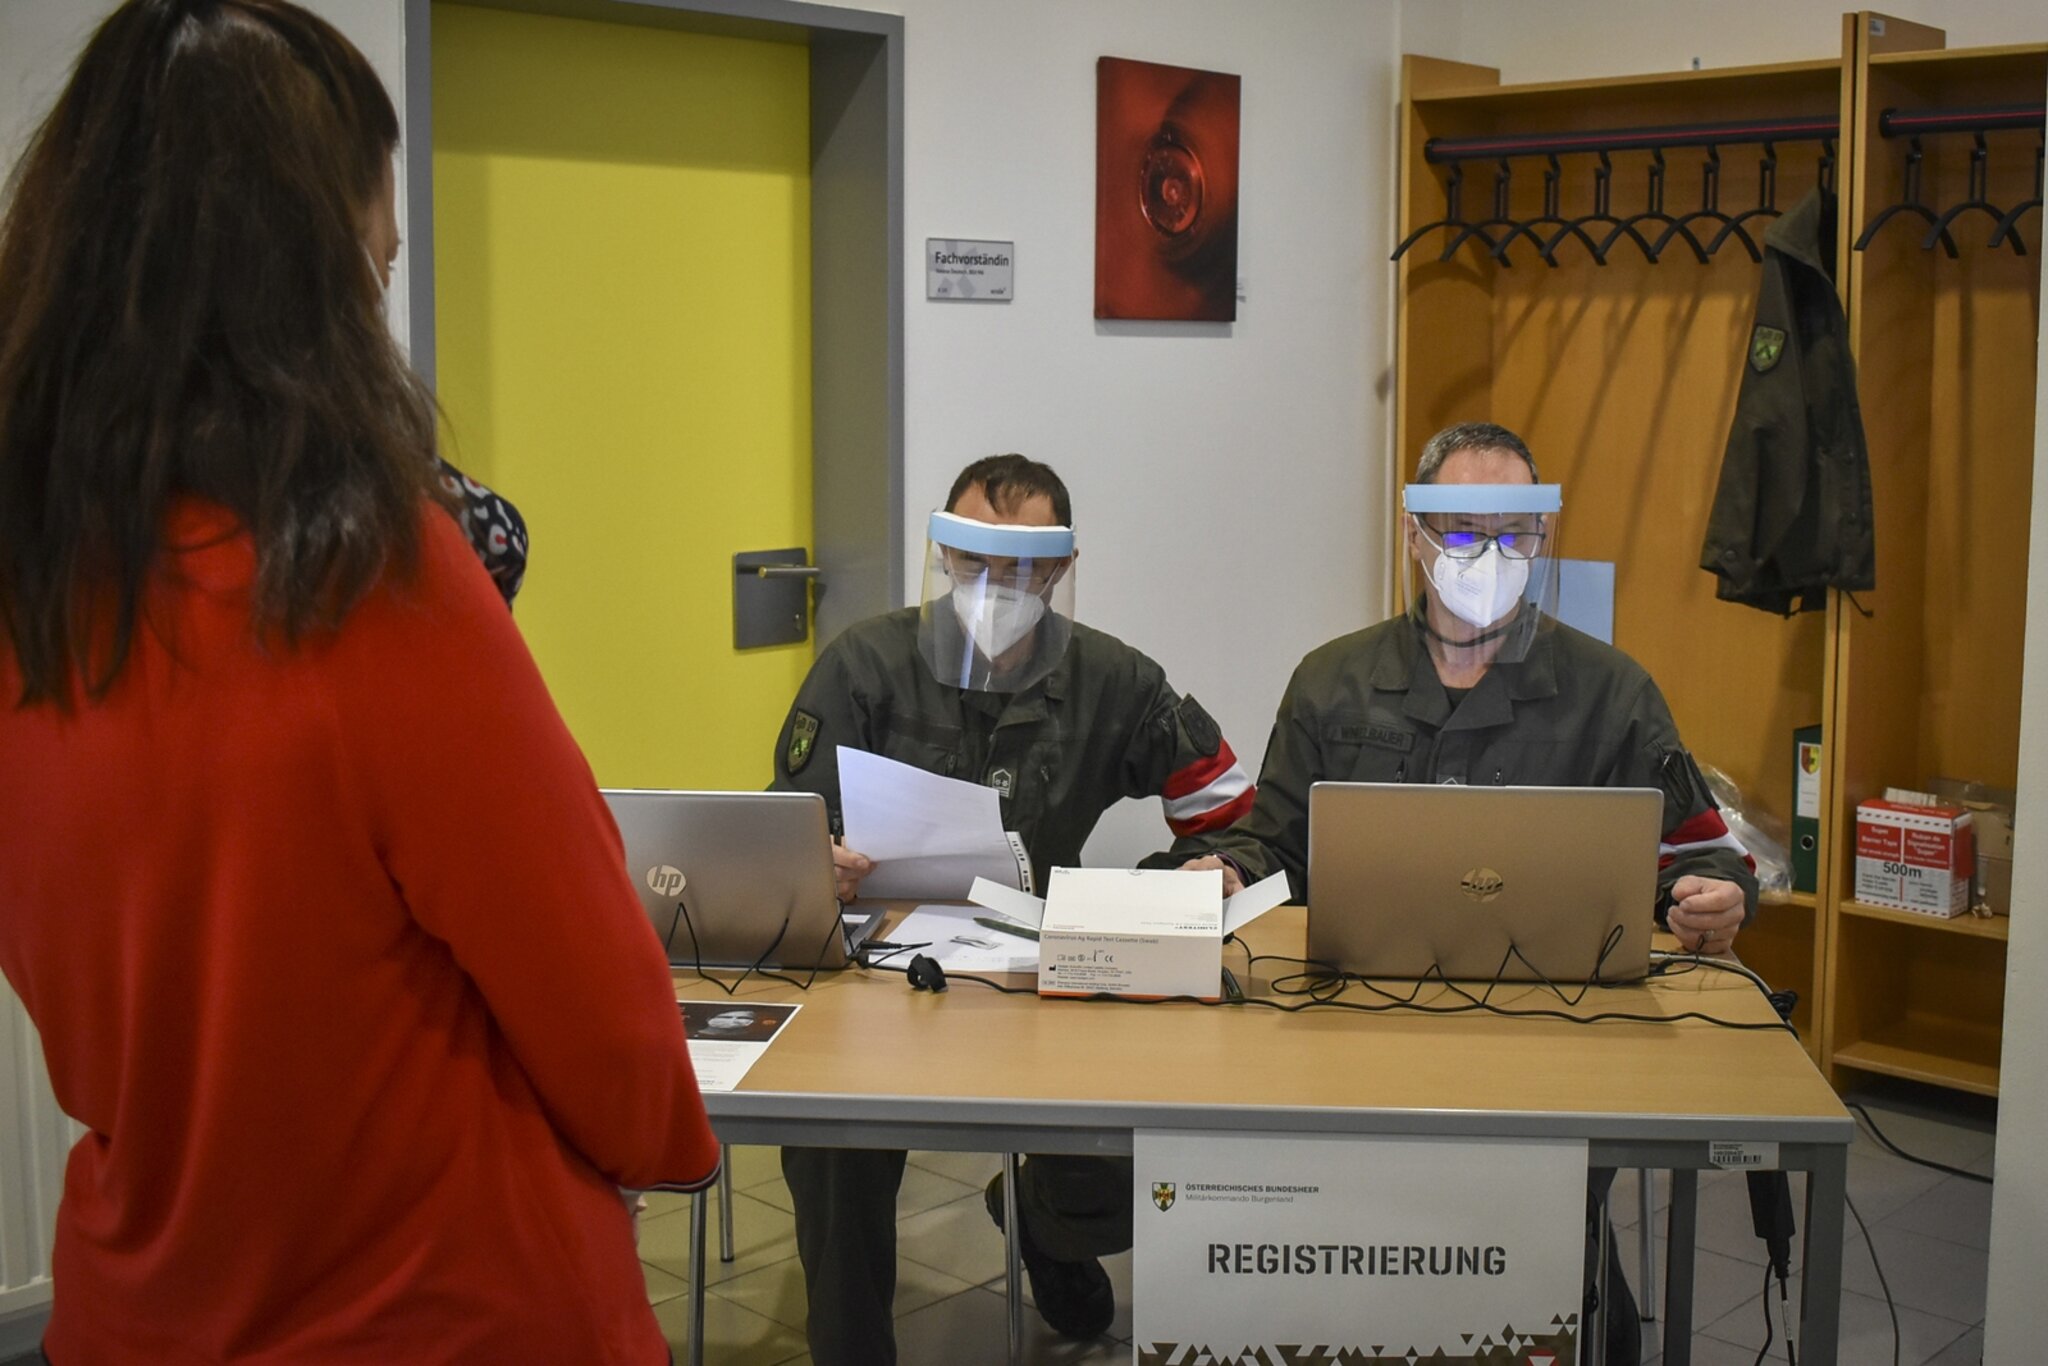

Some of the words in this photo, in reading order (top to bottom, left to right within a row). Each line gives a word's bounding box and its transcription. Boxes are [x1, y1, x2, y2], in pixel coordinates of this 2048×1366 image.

[935, 251, 1009, 267] Fachvorständin
[1883, 861, 1922, 878] 500m
[652, 864, 682, 896] hp
[1185, 1182, 1264, 1192] ÖSTERREICHISCHES
[1265, 1185, 1320, 1193] BUNDESHEER
[1185, 1193, 1250, 1202] Militärkommando
[1251, 1195, 1294, 1204] Burgenland
[1207, 1243, 1507, 1276] REGISTRIERUNG
